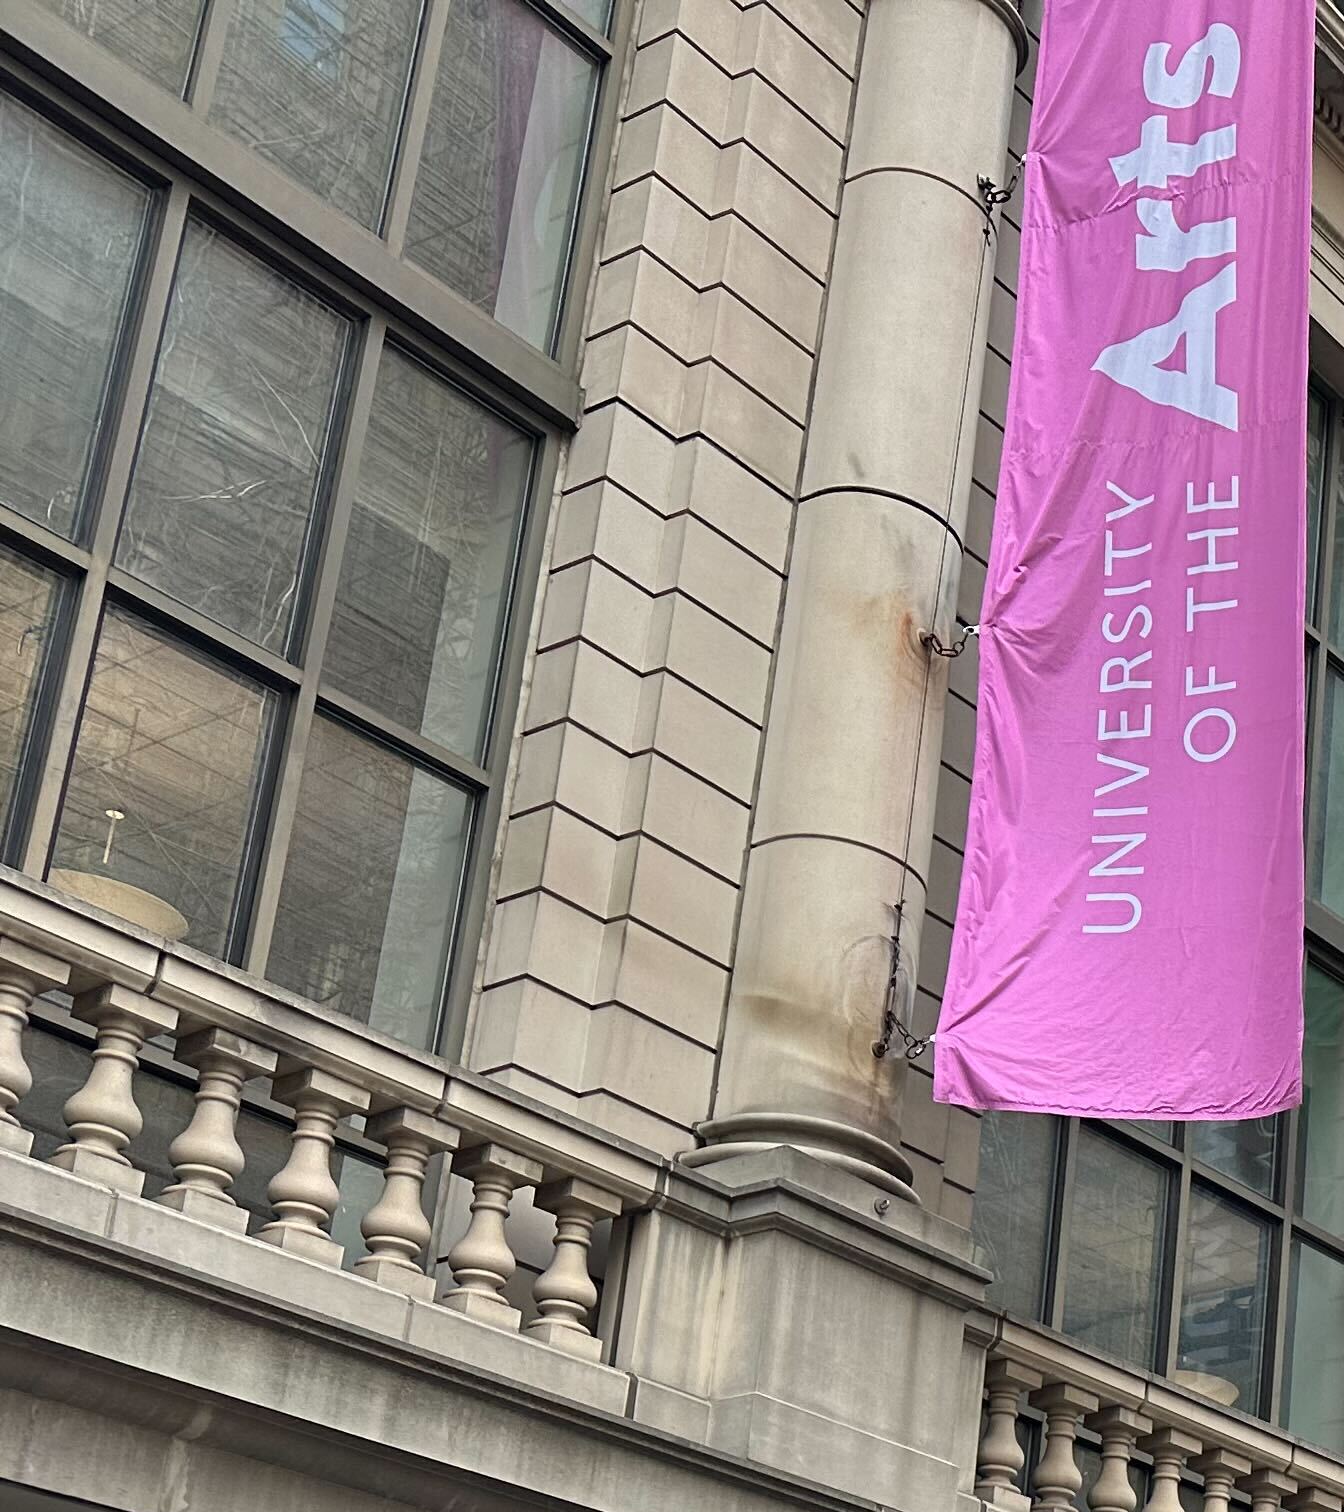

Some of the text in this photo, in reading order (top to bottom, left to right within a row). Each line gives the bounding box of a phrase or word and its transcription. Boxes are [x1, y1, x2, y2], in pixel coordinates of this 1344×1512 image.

[1091, 21, 1242, 432] Arts
[1082, 480, 1157, 934] UNIVERSITY
[1184, 473, 1240, 763] OF THE
